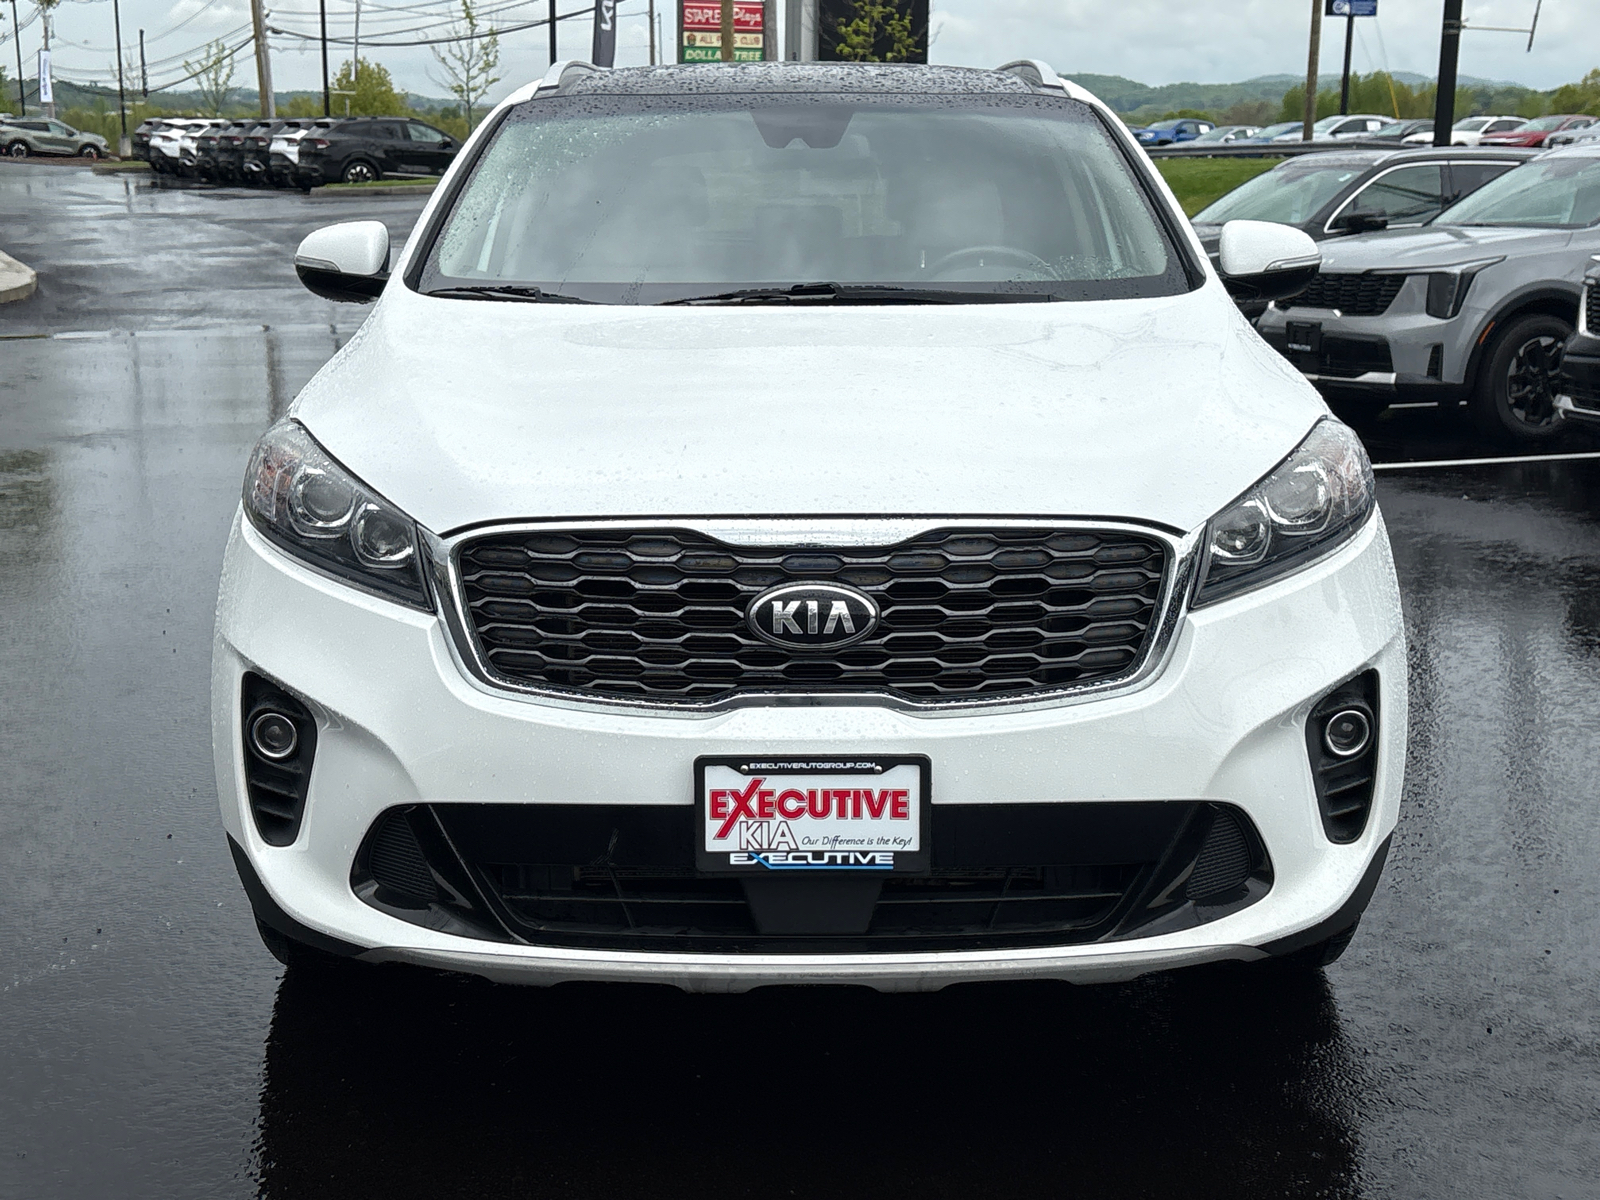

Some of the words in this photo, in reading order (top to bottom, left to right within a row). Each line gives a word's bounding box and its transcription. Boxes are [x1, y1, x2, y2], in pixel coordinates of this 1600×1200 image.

[684, 8, 722, 23] STAPLE
[685, 50, 722, 60] DOLLA
[734, 51, 762, 61] TREE
[771, 600, 856, 634] KIA
[709, 777, 910, 840] EXECUTIVE
[739, 820, 800, 850] KIA
[801, 836, 820, 846] Our
[821, 835, 866, 850] Difference
[866, 837, 875, 846] is
[876, 836, 891, 846] the
[729, 852, 894, 868] EXECUTIVE
